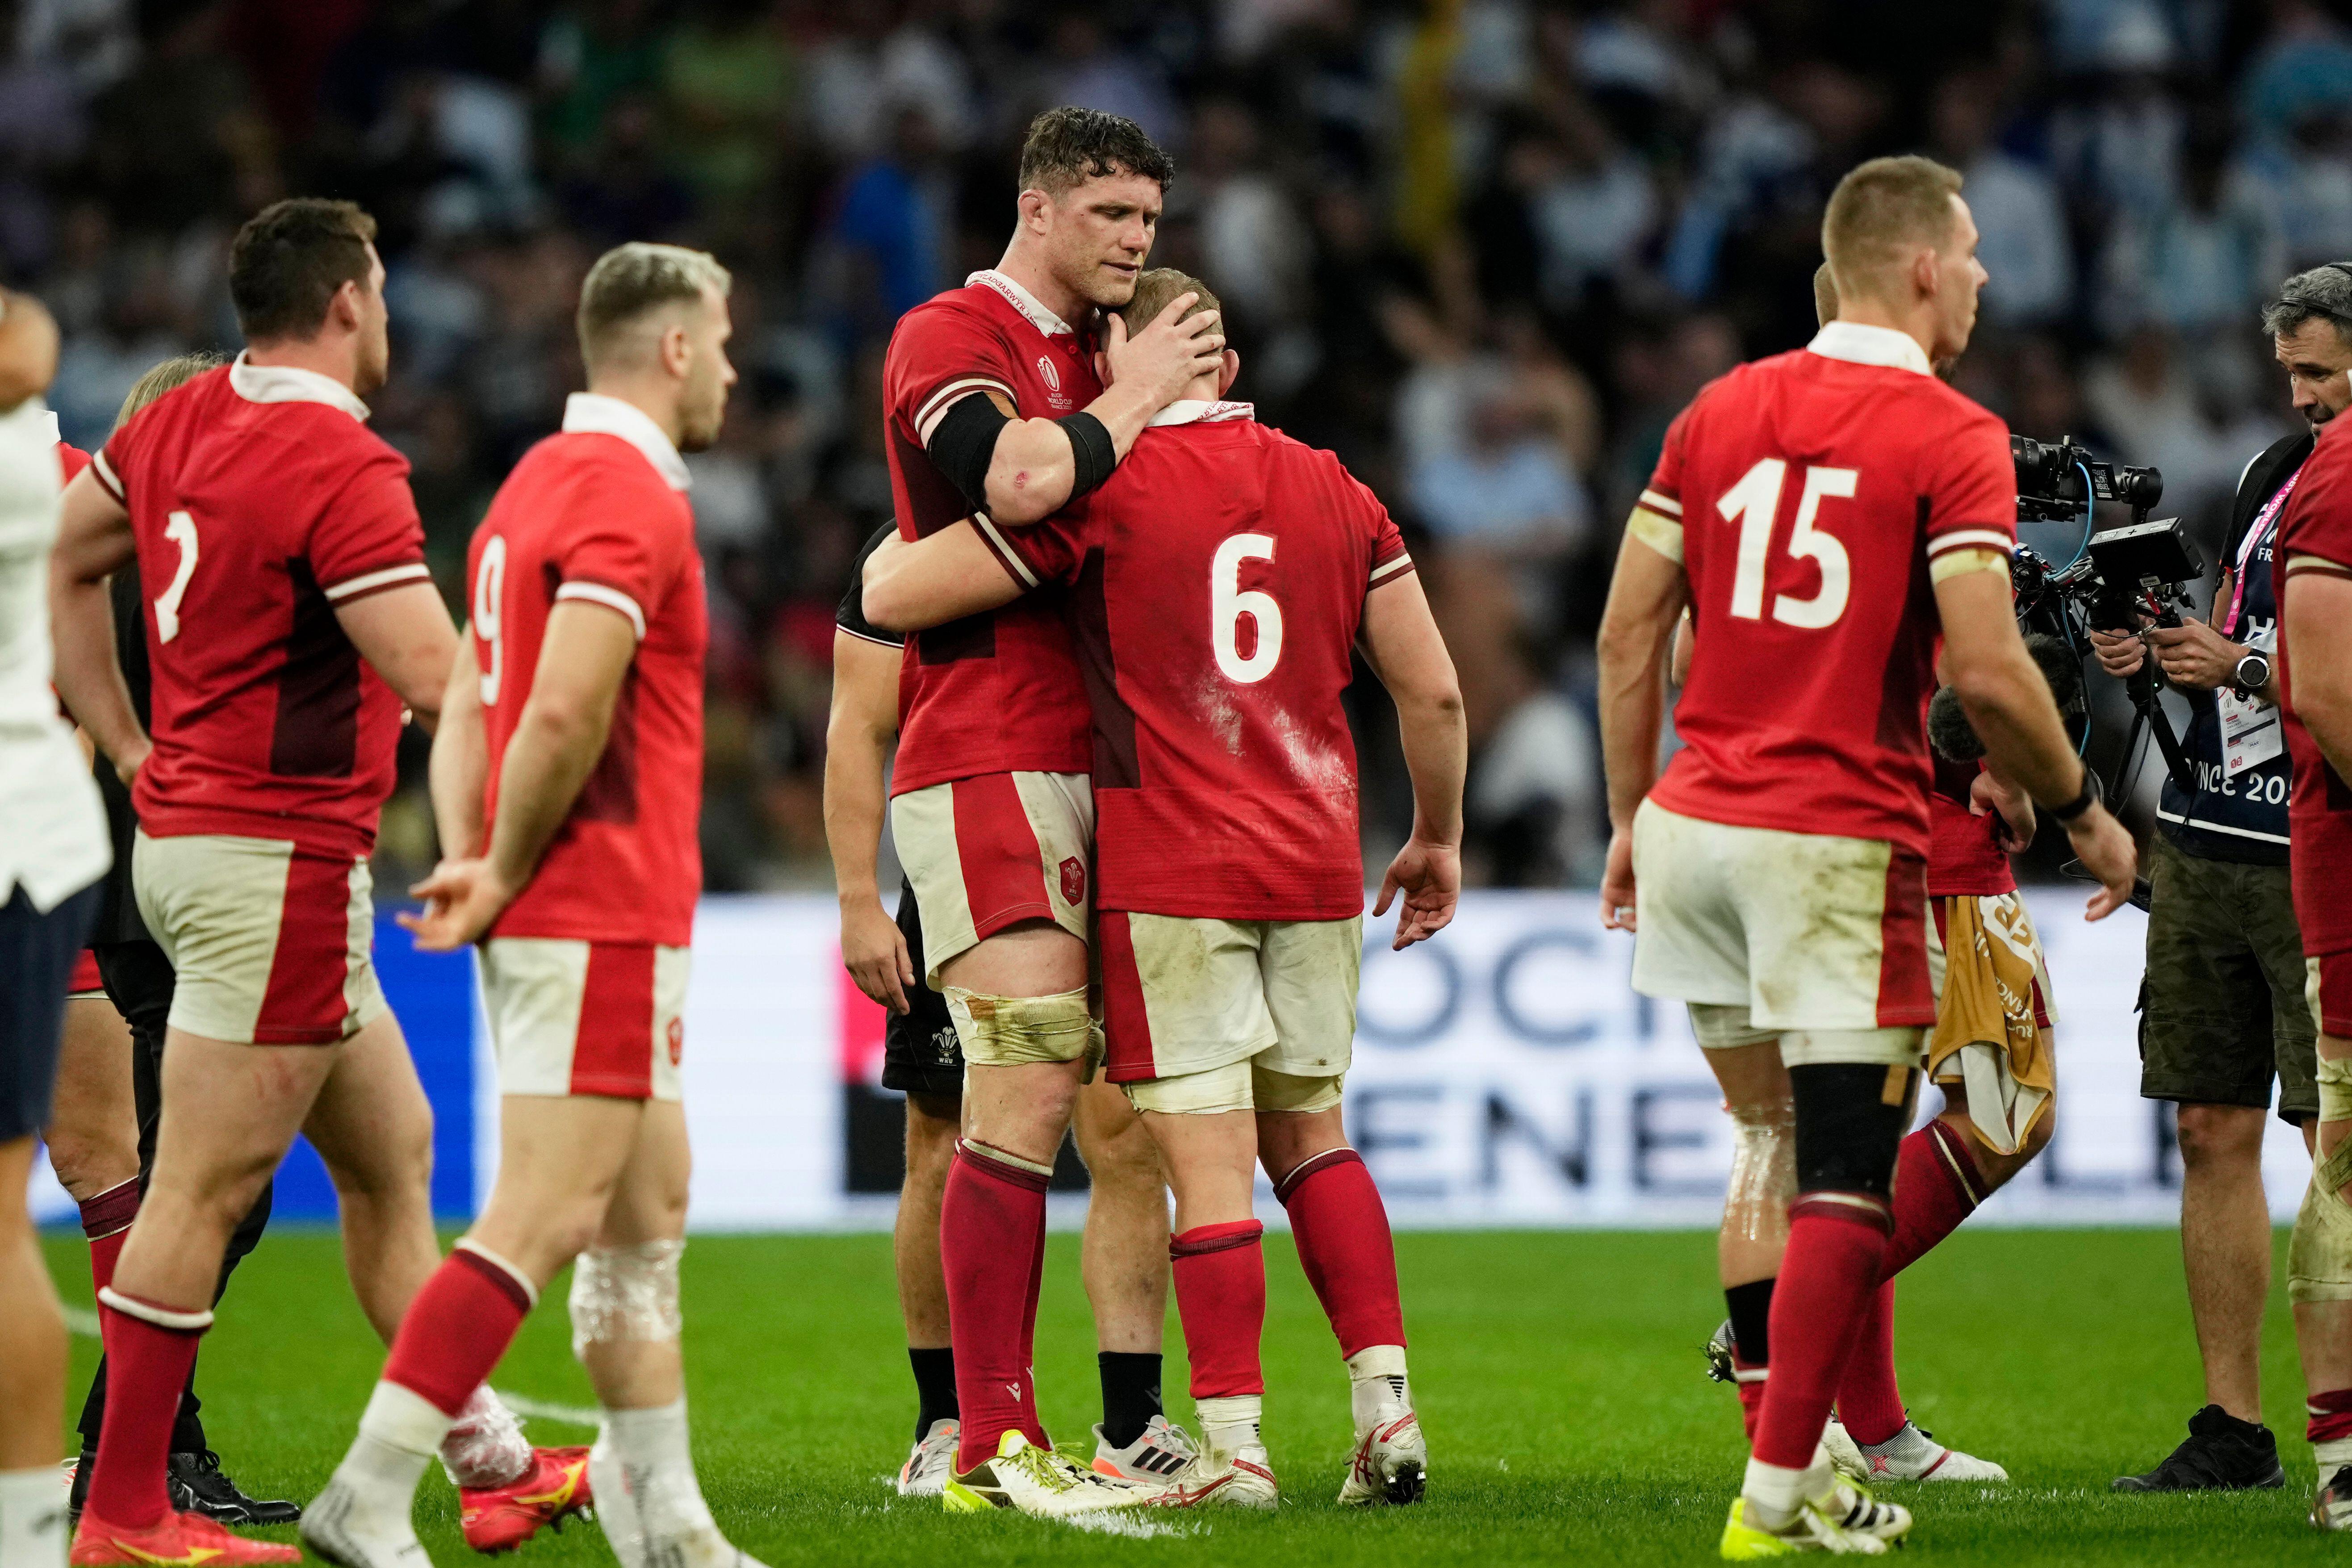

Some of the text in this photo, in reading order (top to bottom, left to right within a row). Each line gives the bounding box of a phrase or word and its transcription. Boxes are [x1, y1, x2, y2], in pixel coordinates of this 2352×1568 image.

[1046, 397, 1063, 405] WORLD
[2095, 475, 2108, 484] AUDIO
[2258, 494, 2286, 532] WORLD
[1716, 457, 1859, 629] 15
[474, 534, 507, 706] 9
[1211, 533, 1283, 684] 6
[2246, 772, 2293, 807] 20
